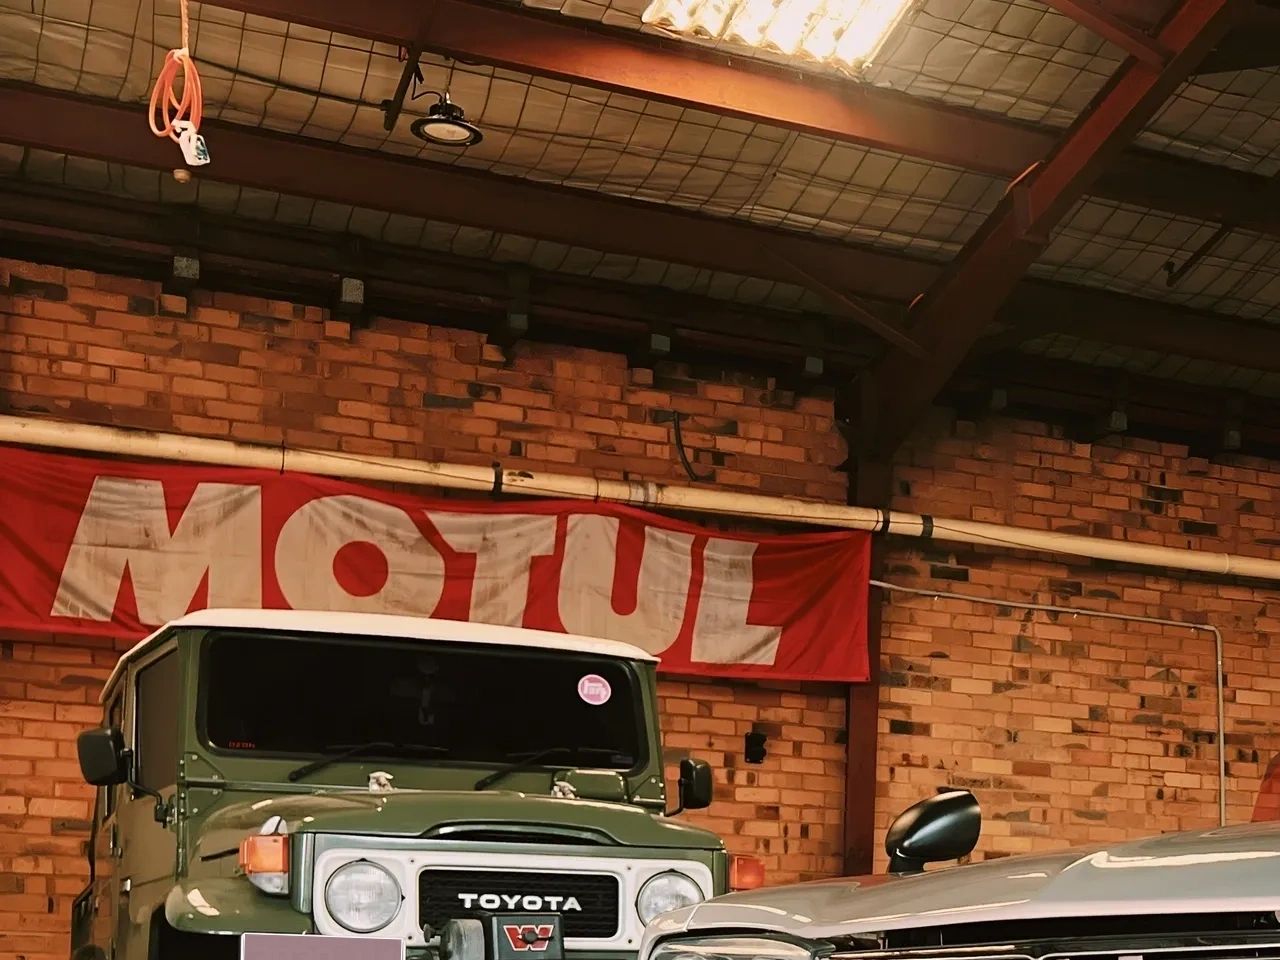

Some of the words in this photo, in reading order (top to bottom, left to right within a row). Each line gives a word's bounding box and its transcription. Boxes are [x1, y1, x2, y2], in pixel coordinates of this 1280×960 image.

[50, 475, 785, 667] MOTUL
[457, 892, 583, 912] TOYOTA
[502, 924, 555, 952] W
